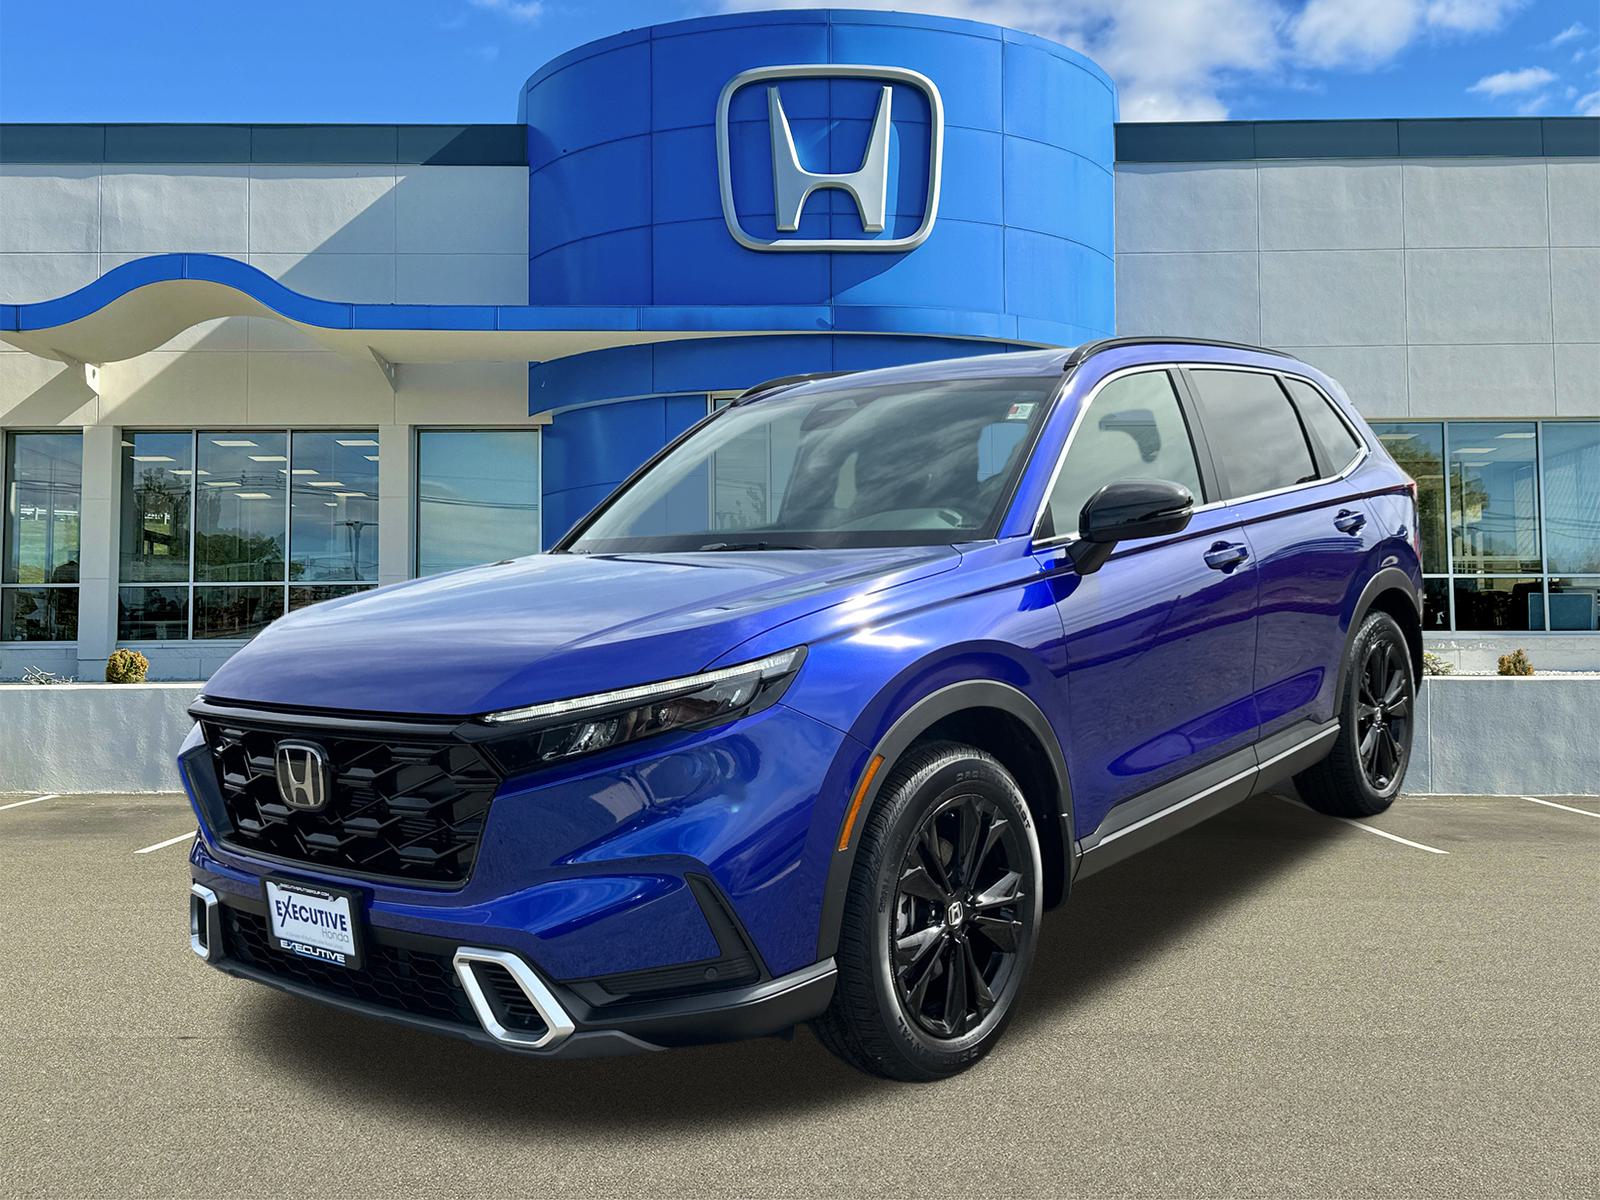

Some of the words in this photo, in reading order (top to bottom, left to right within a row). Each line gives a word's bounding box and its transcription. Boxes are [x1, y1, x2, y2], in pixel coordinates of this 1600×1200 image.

[275, 895, 347, 932] EXECUTIVE
[321, 928, 349, 943] Honda
[280, 939, 346, 963] EXECUTIVE
